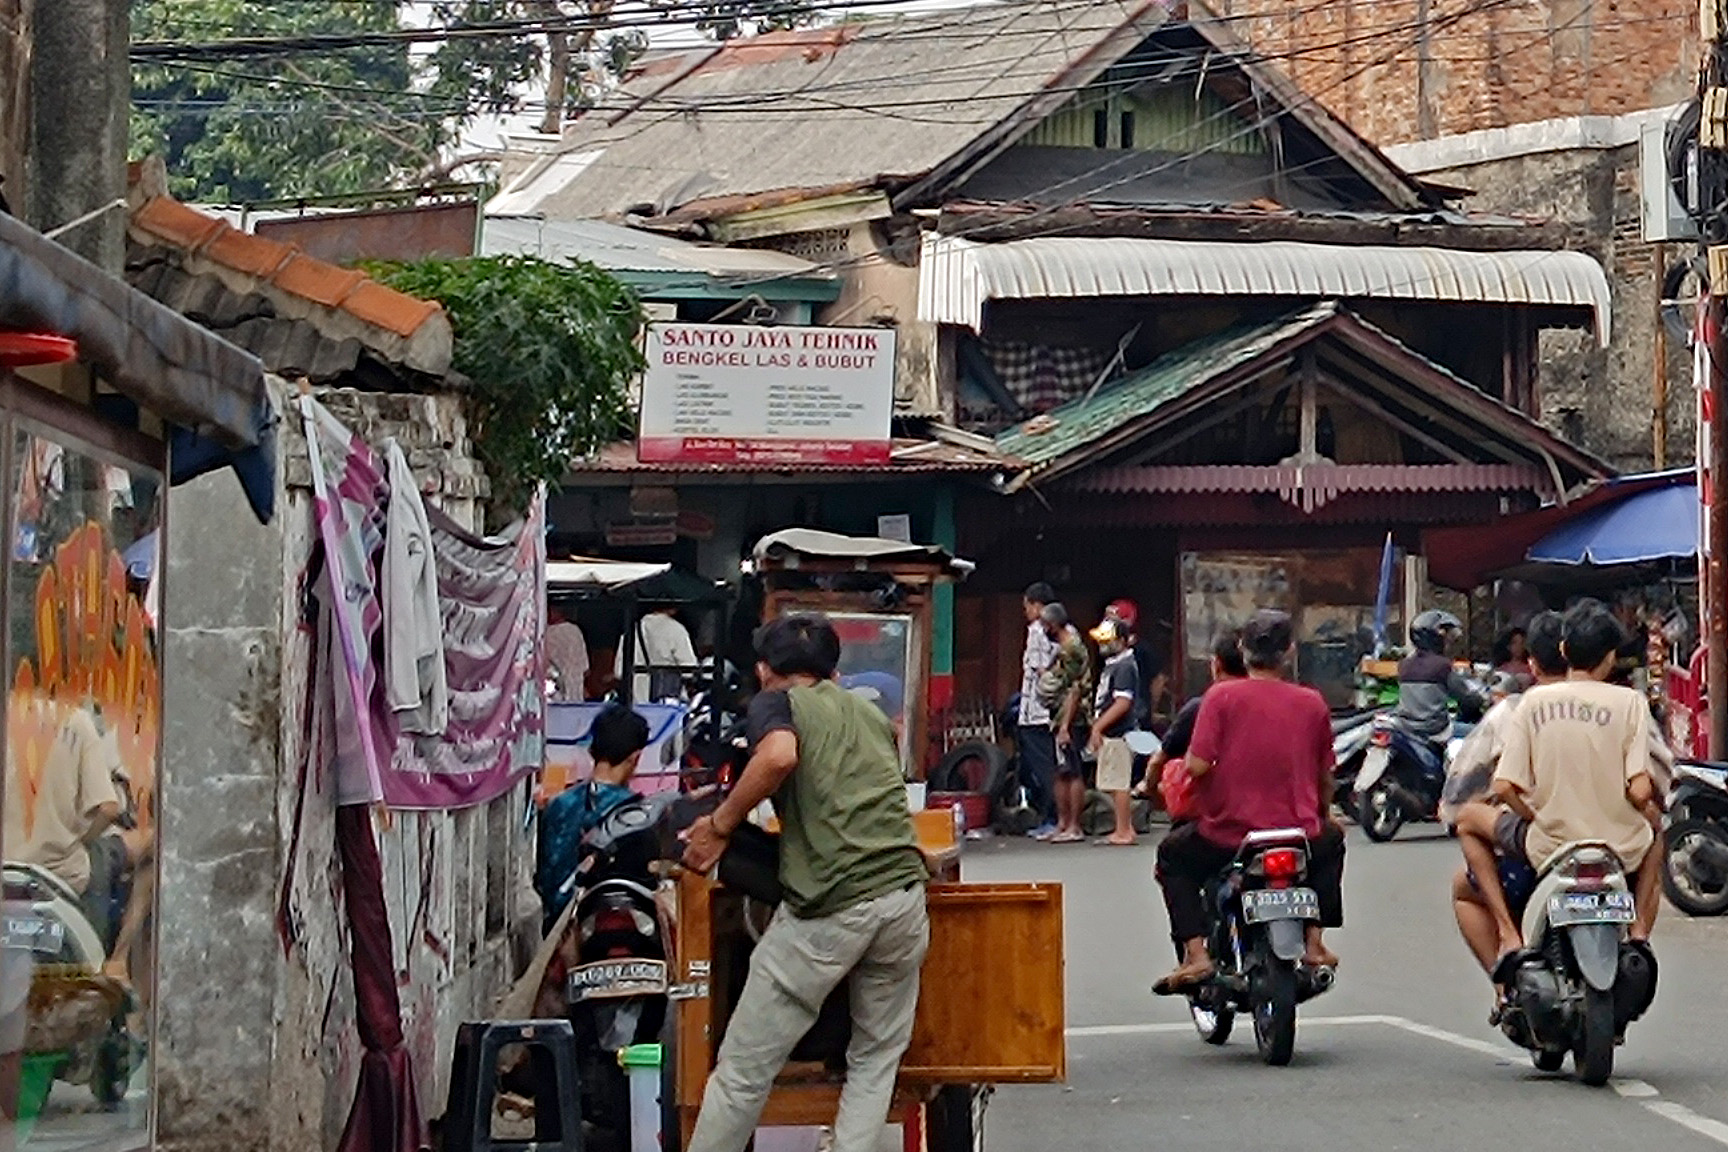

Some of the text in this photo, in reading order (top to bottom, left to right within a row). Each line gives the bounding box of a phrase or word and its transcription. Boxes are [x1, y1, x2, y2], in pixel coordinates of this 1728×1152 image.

[663, 329, 878, 350] SANTO JAYA TEHNIK
[663, 351, 876, 368] BENGKEL LAS & BUBUT
